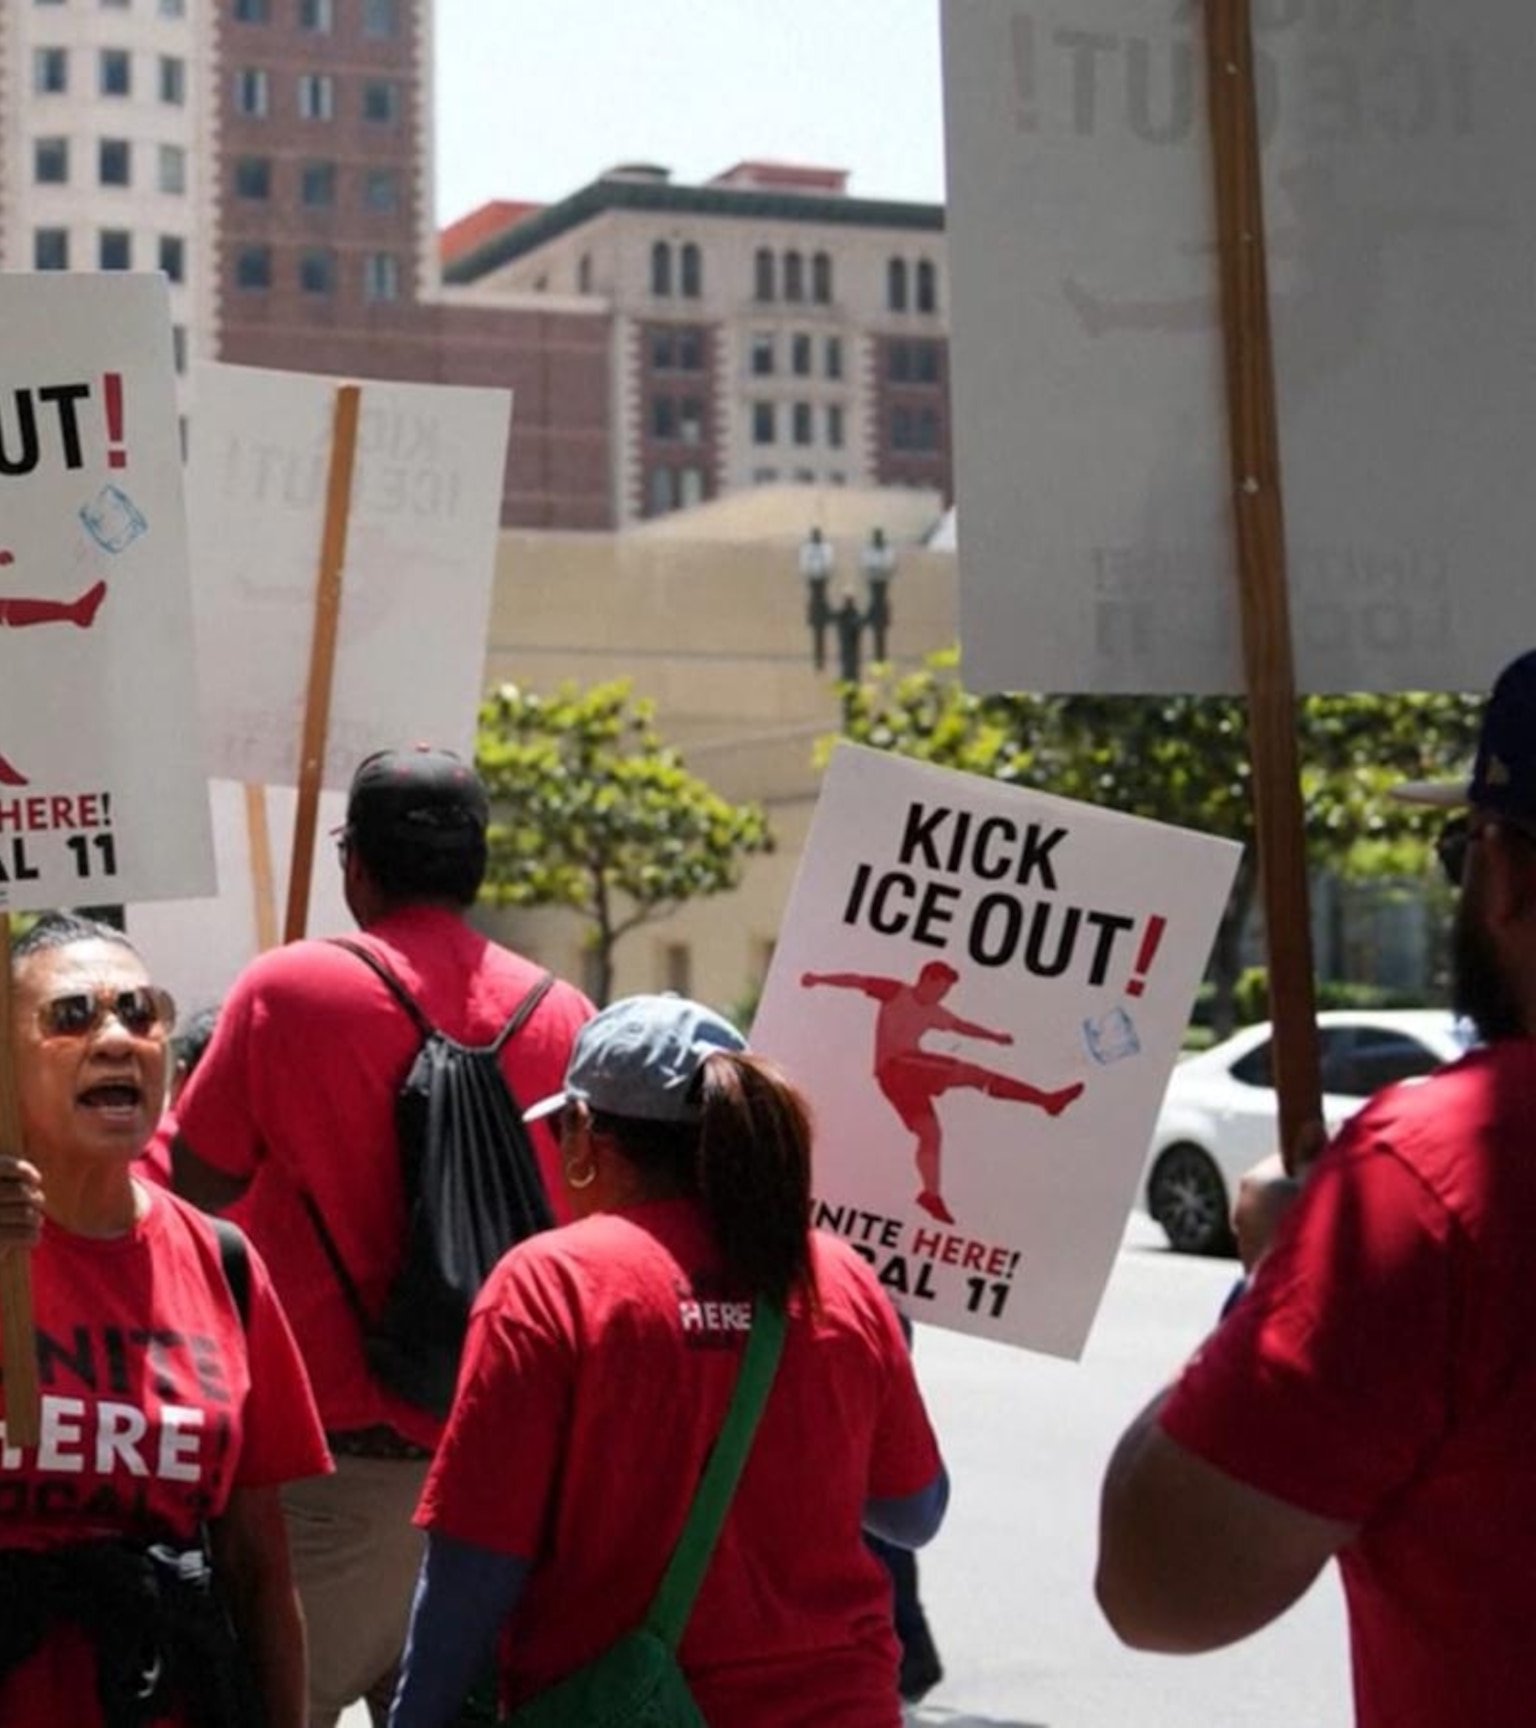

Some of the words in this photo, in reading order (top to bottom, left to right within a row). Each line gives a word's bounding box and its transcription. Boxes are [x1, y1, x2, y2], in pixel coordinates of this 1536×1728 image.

[66, 833, 118, 878] 11
[899, 802, 1070, 891] KICK
[843, 863, 962, 949] ICE
[968, 893, 1168, 999] OUT!
[911, 1228, 1022, 1279] HERE!
[965, 1276, 1012, 1320] 11
